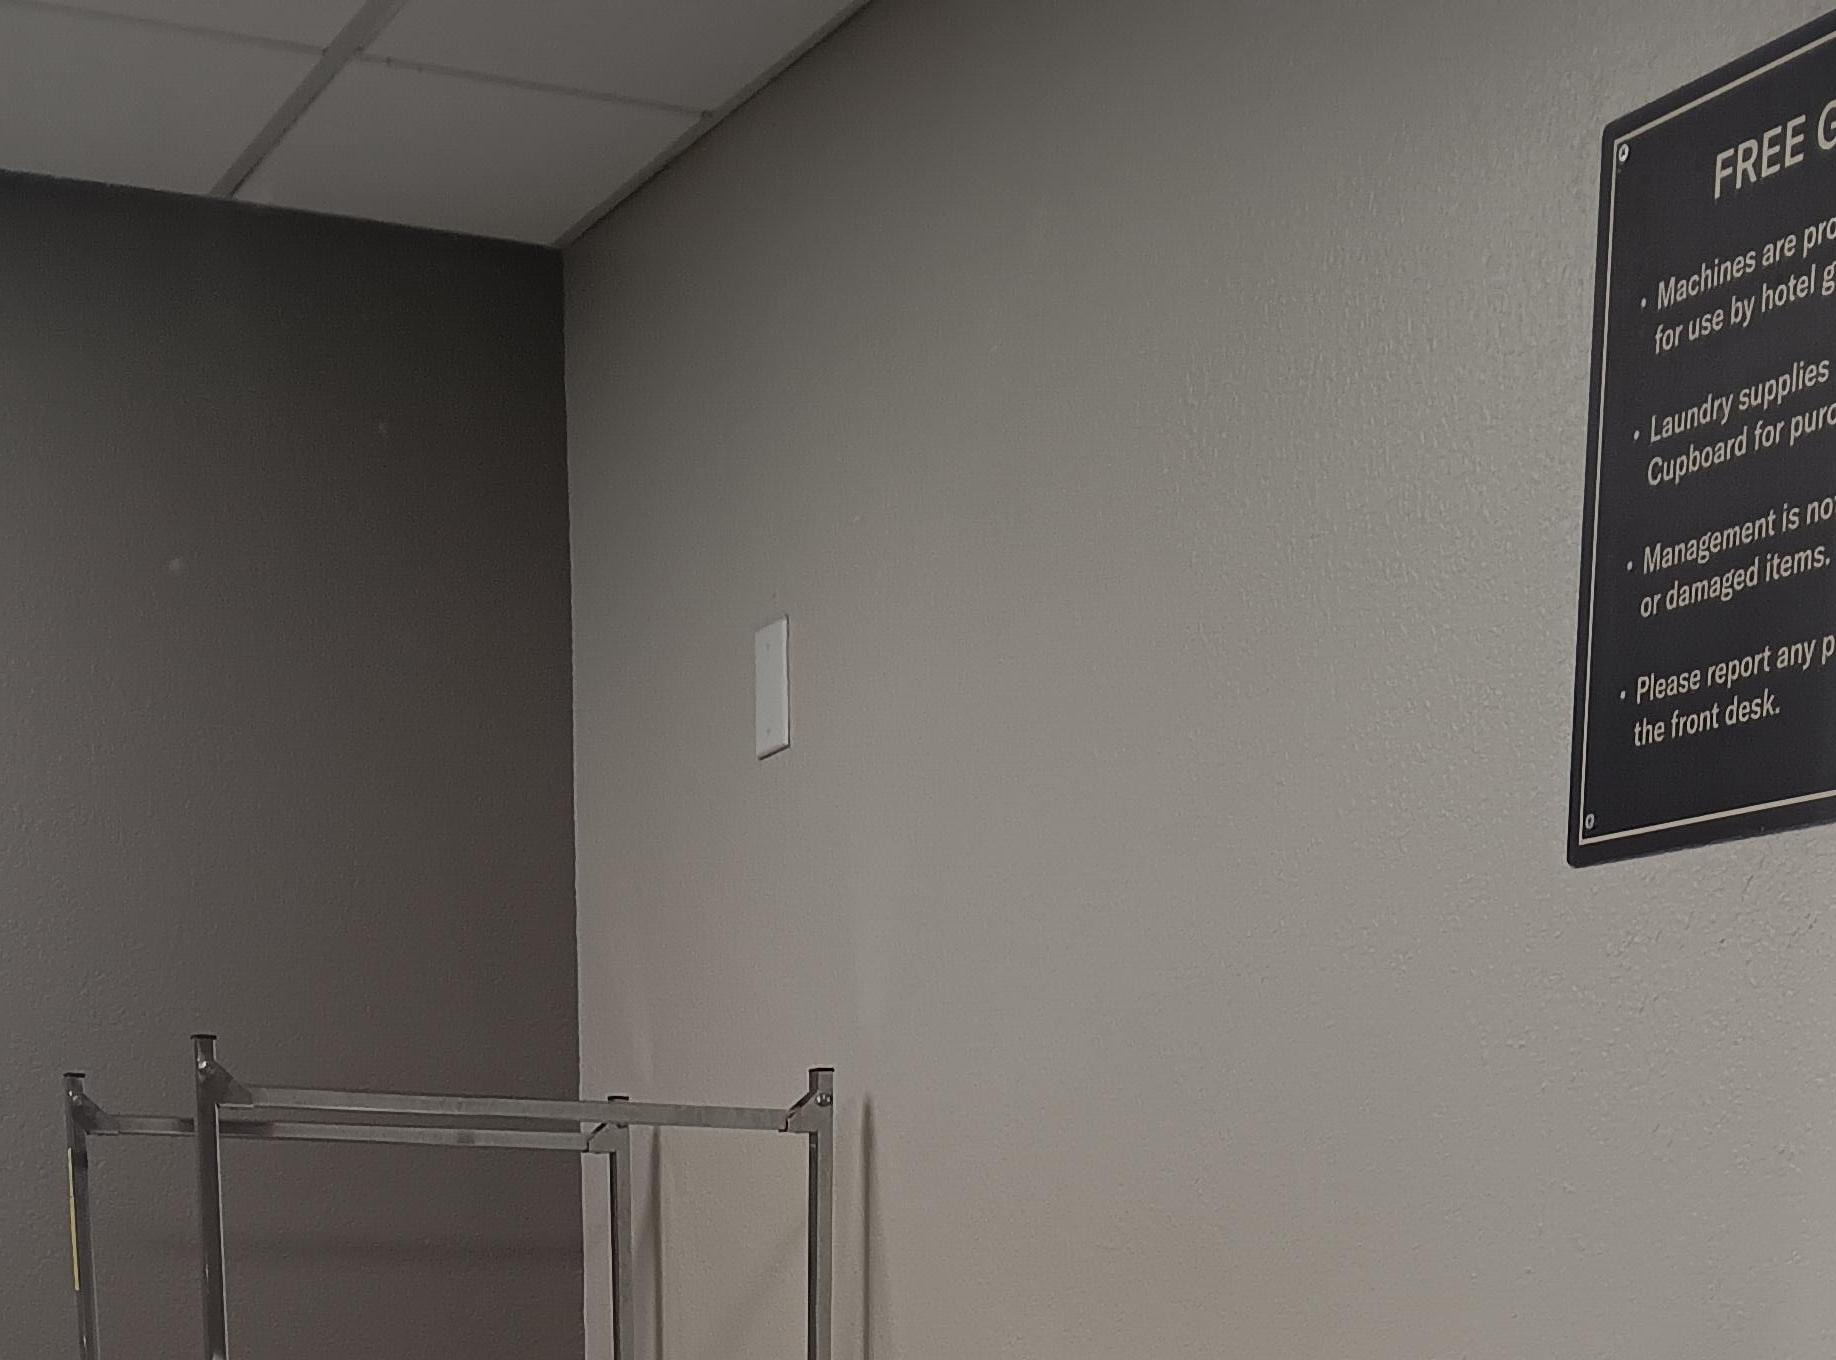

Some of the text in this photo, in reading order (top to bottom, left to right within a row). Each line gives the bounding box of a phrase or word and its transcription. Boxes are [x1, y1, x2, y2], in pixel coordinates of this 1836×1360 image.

[1714, 114, 1806, 200] FREE
[1656, 216, 1836, 310] Machines are pro
[1655, 323, 1684, 354] for
[1688, 308, 1724, 341] use
[1731, 295, 1754, 327] by
[1761, 266, 1815, 313] hotel
[1650, 358, 1830, 443] Laundry supplies
[1647, 432, 1747, 487] Cupboard
[1754, 418, 1784, 450] for
[1643, 508, 1775, 574] Management
[1782, 502, 1800, 532] is
[1640, 545, 1831, 619] or damaged items.
[1636, 667, 1701, 704] Please
[1707, 644, 1771, 691] report
[1776, 637, 1815, 673] any
[1633, 688, 1781, 747] the front desk.
